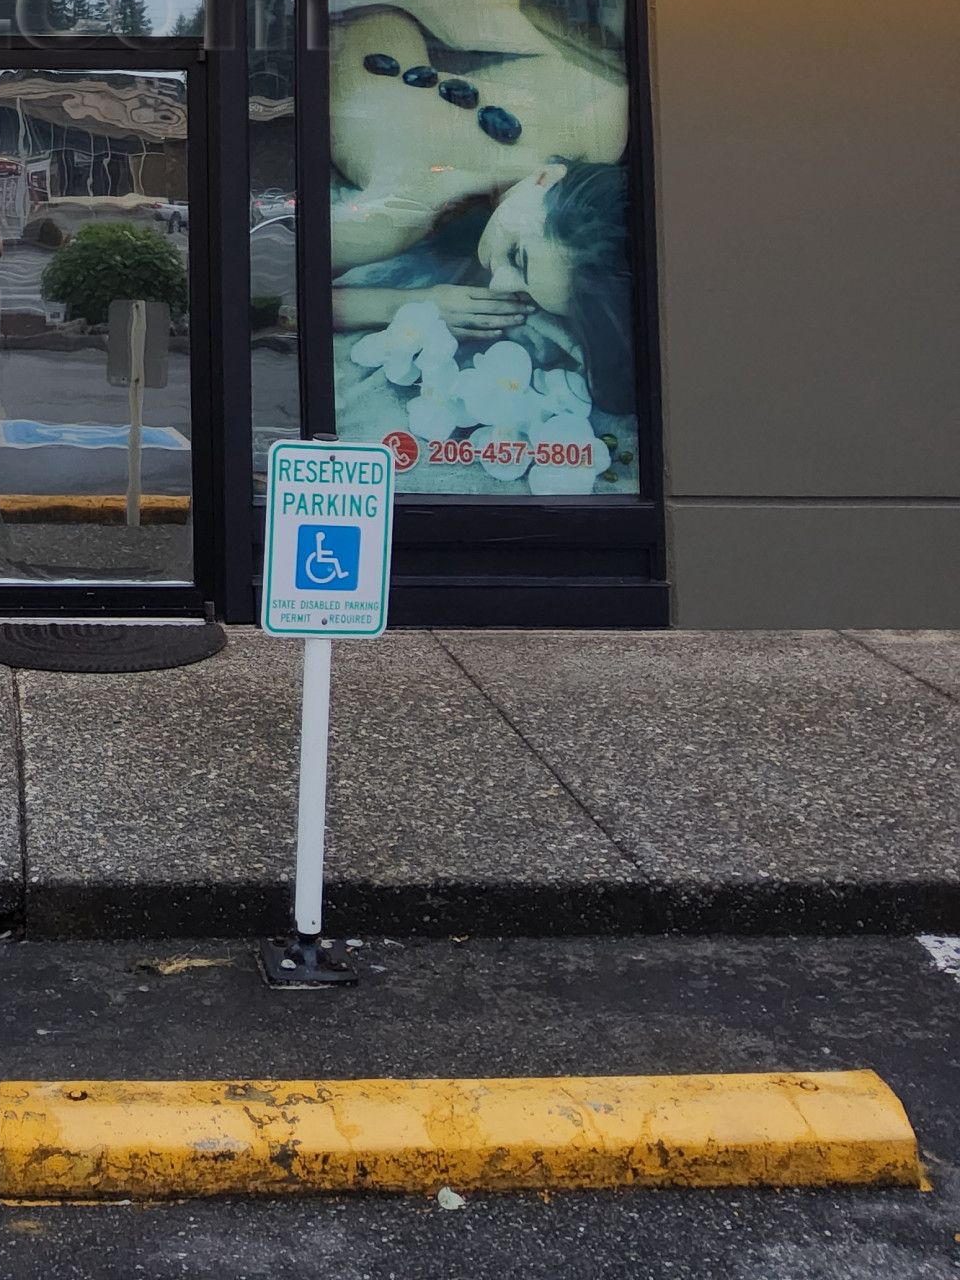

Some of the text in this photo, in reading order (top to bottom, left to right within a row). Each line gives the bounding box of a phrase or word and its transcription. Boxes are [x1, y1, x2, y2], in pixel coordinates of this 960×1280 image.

[428, 440, 593, 466] 206-457-5801
[278, 458, 384, 485] RESERVED
[282, 492, 378, 518] PARKING
[272, 599, 379, 612] STATE DISABLED PARKING
[280, 613, 372, 625] PERMIT REQUIRED
